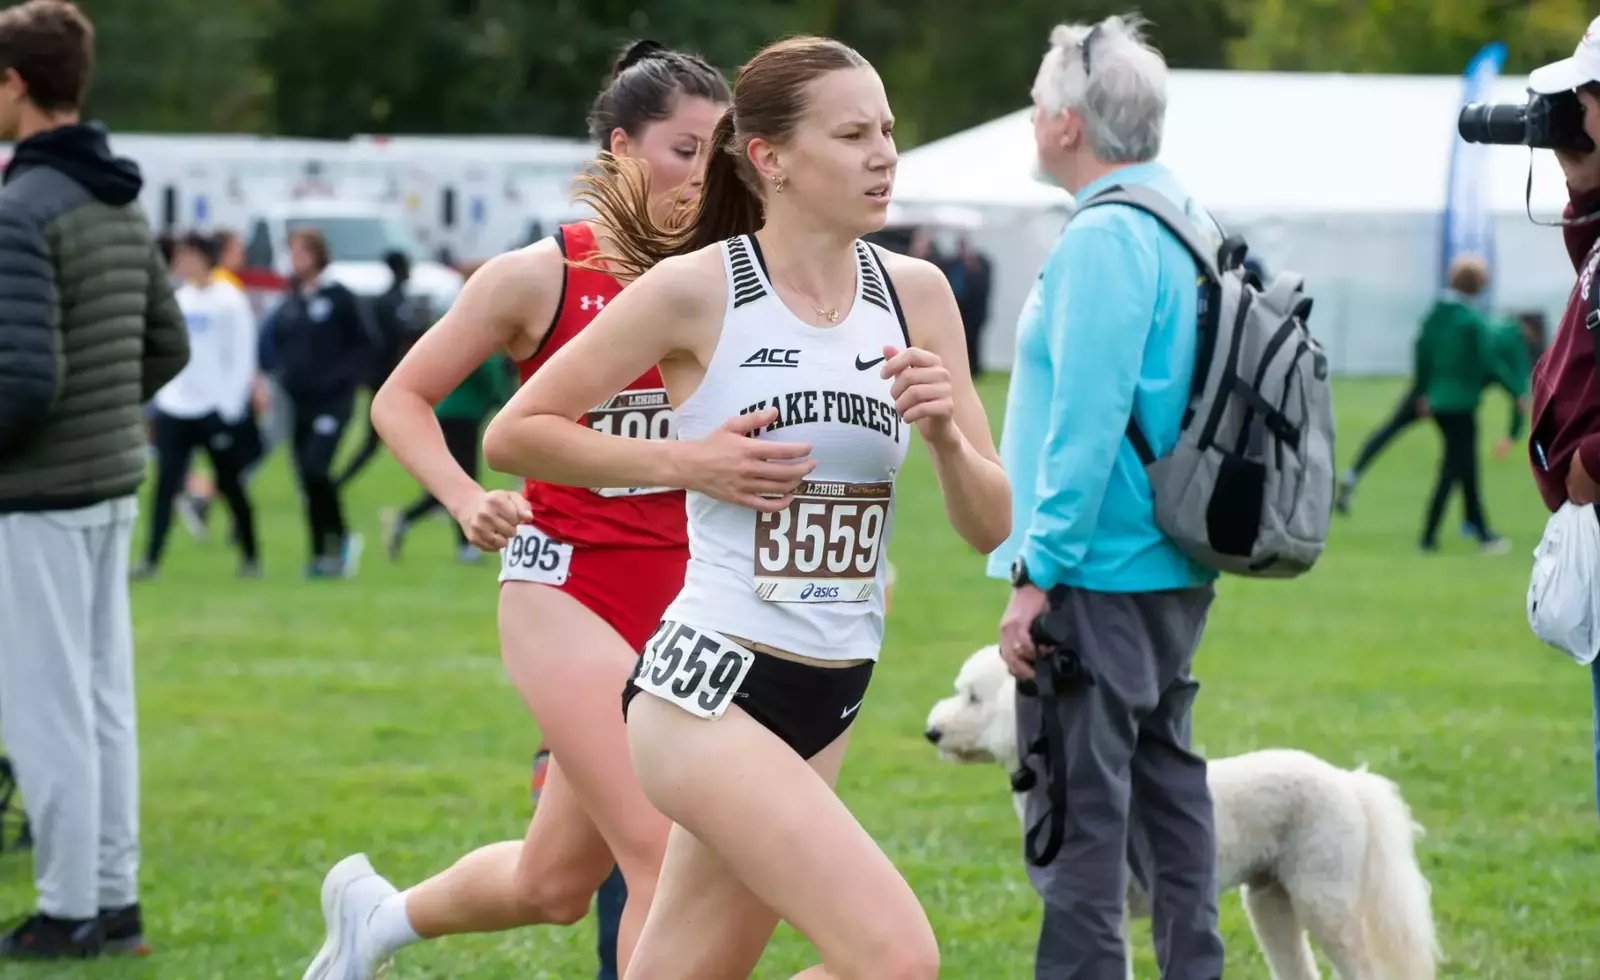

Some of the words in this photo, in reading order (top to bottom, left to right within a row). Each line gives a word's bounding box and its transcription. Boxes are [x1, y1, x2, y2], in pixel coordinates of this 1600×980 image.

[744, 348, 803, 363] ACC
[628, 394, 664, 405] LEHIGH
[823, 391, 901, 443] FOREST
[806, 483, 846, 496] LEHIGH
[758, 503, 884, 573] 3559
[813, 586, 839, 597] asics
